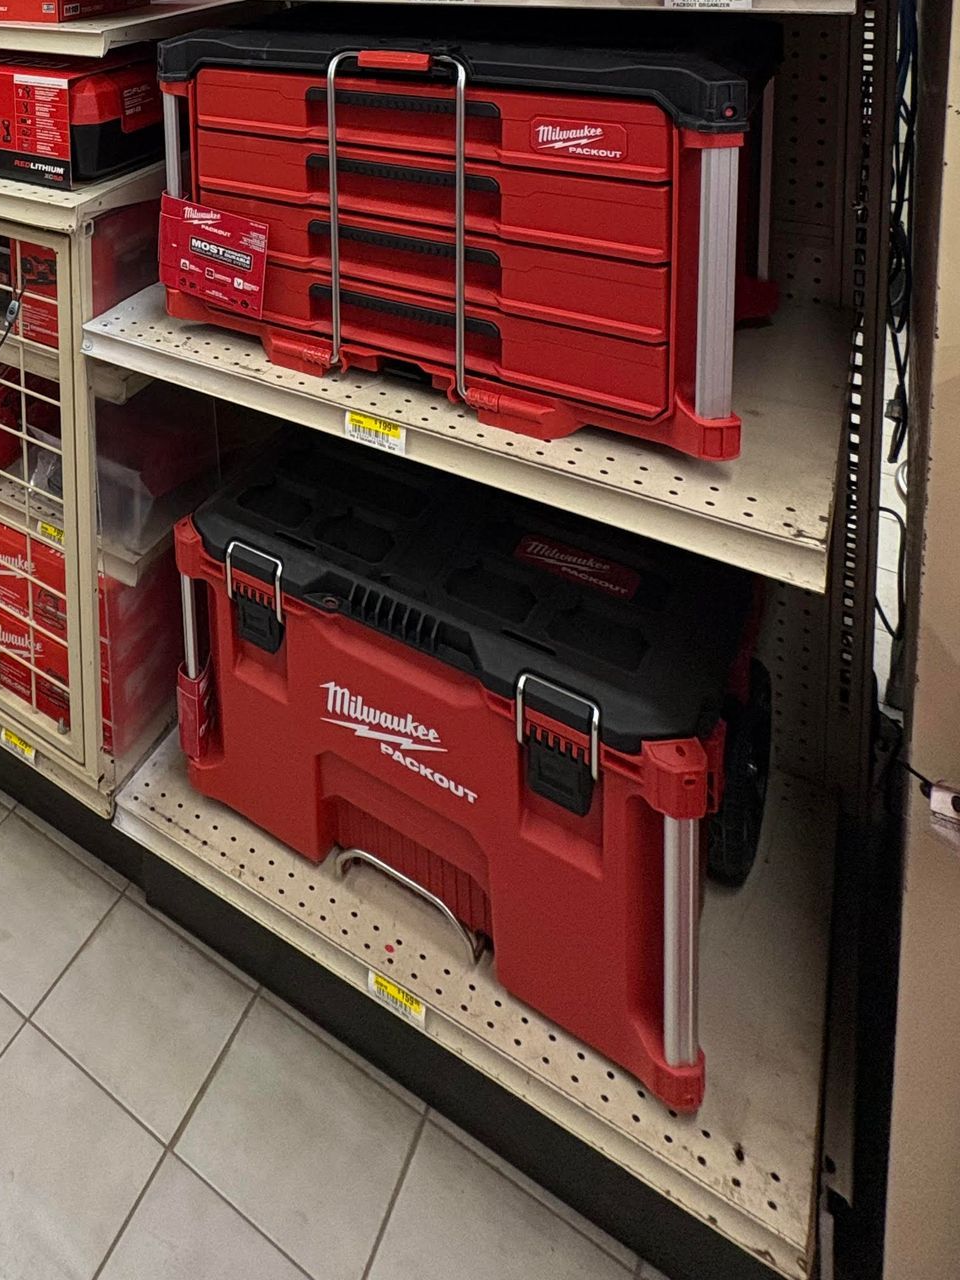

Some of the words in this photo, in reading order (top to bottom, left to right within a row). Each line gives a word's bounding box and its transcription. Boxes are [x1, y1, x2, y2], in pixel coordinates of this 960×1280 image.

[535, 125, 603, 142] Milwaukee
[569, 147, 622, 158] PACKOUT
[14, 160, 64, 175] REDLITHIUM
[184, 206, 221, 219] Milwaukee
[201, 224, 231, 237] PACKOUT
[192, 238, 224, 255] MOST
[526, 541, 610, 570] Milwaukee
[561, 566, 628, 594] PACKOUT
[320, 681, 441, 744] Milwaukee
[380, 742, 478, 804] PACKOUT
